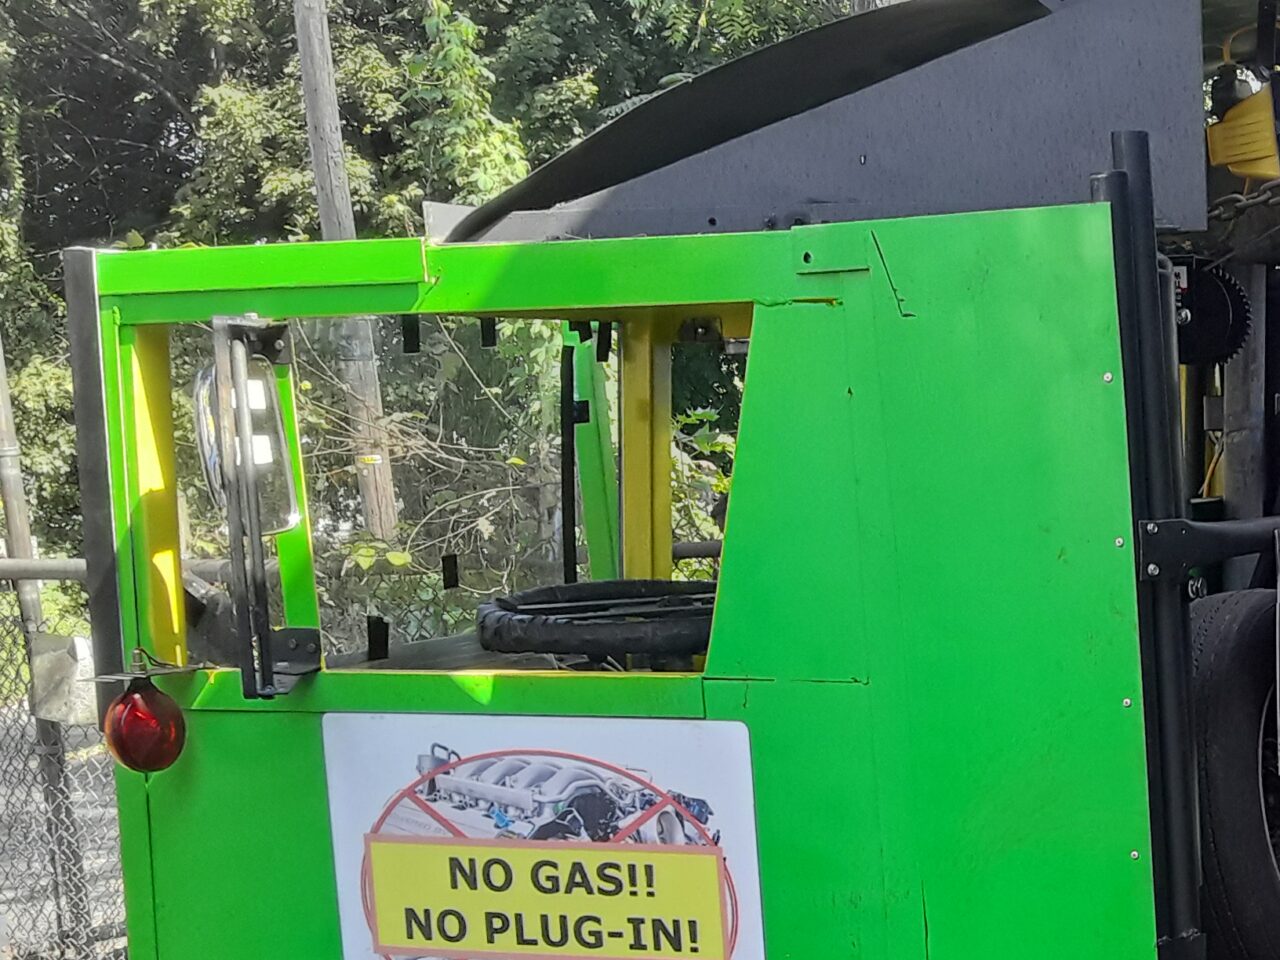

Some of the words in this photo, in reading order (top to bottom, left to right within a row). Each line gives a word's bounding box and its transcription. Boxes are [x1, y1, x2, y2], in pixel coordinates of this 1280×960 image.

[448, 857, 514, 892] NO
[530, 860, 655, 897] GAS!!
[404, 907, 468, 943] NO
[484, 911, 700, 953] PLUG-IN!
